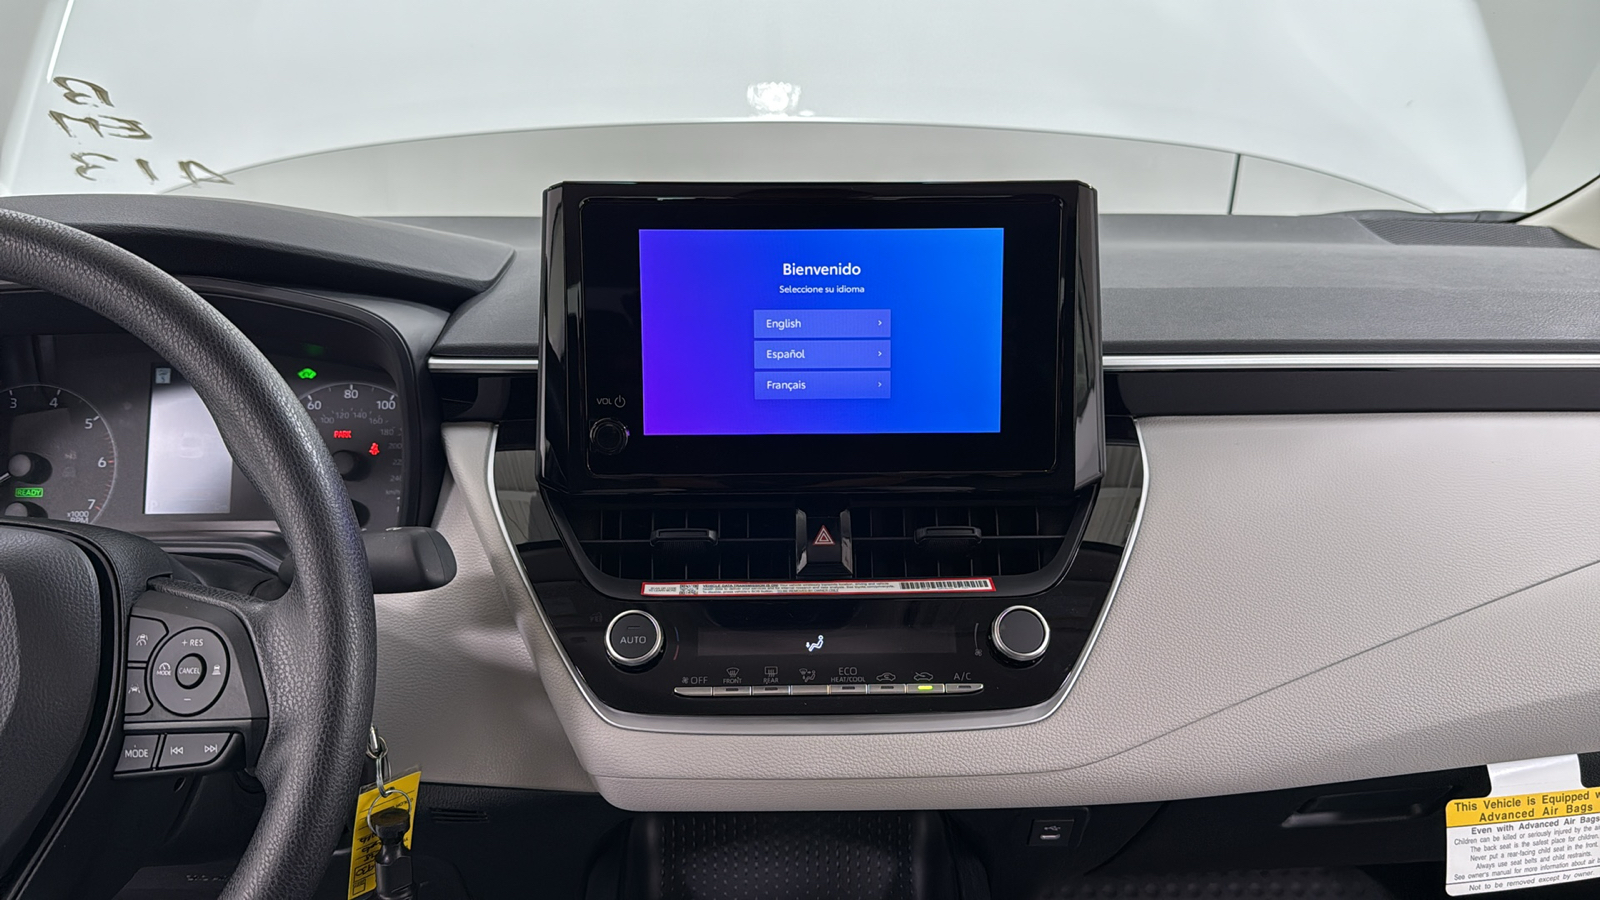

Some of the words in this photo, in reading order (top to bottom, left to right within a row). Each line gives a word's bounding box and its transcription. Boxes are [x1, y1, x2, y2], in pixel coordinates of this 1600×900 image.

[782, 262, 861, 276] Bienvenido
[779, 284, 824, 294] Seleccione
[824, 286, 835, 294] su
[836, 284, 865, 294] idioma
[766, 318, 802, 331] English
[766, 349, 806, 361] Español
[766, 380, 806, 392] Français
[343, 389, 359, 399] 80
[9, 398, 18, 409] 3
[49, 397, 58, 408] 4
[306, 401, 322, 410] 60
[376, 400, 396, 410] 100
[596, 397, 612, 405] VOL
[320, 416, 335, 424] 100
[336, 412, 350, 420] 120
[353, 412, 368, 420] 140
[369, 417, 384, 425] 160
[84, 418, 94, 430] 5
[333, 430, 352, 438] PARK
[97, 456, 107, 468] 6
[88, 499, 96, 510] 7
[189, 639, 204, 647] RES
[620, 636, 647, 644] AUTO
[178, 667, 200, 675] CANCEL
[838, 667, 858, 676] ECO
[954, 672, 972, 681] A/C
[690, 676, 708, 684] OFF
[124, 749, 149, 758] MODE
[1454, 802, 1478, 812] This
[1483, 798, 1521, 810] Vehicle
[1527, 796, 1536, 806] is
[1542, 791, 1590, 806] Equipped
[1479, 808, 1535, 822] Advanced
[1542, 806, 1558, 816] Air
[1566, 804, 1593, 814] Bags
[1471, 827, 1492, 835] Even
[1496, 824, 1514, 832] with
[1518, 820, 1560, 830] Advanced
[1564, 818, 1576, 826] Air
[1454, 838, 1478, 846] Children
[1528, 830, 1552, 838] seriously
[1554, 827, 1572, 836] injured
[1484, 844, 1497, 852] back
[1578, 834, 1600, 842] children.
[1470, 854, 1487, 862] Never
[1507, 849, 1536, 858] rear-facing
[1476, 862, 1496, 870] Always
[1552, 854, 1565, 862] child
[1567, 851, 1592, 859] restraints.
[1468, 872, 1490, 880] owner's
[1492, 868, 1512, 876] manual
[1540, 862, 1569, 870] information
[1469, 884, 1482, 892] Not
[1506, 878, 1536, 886] removed
[1538, 874, 1560, 882] except
